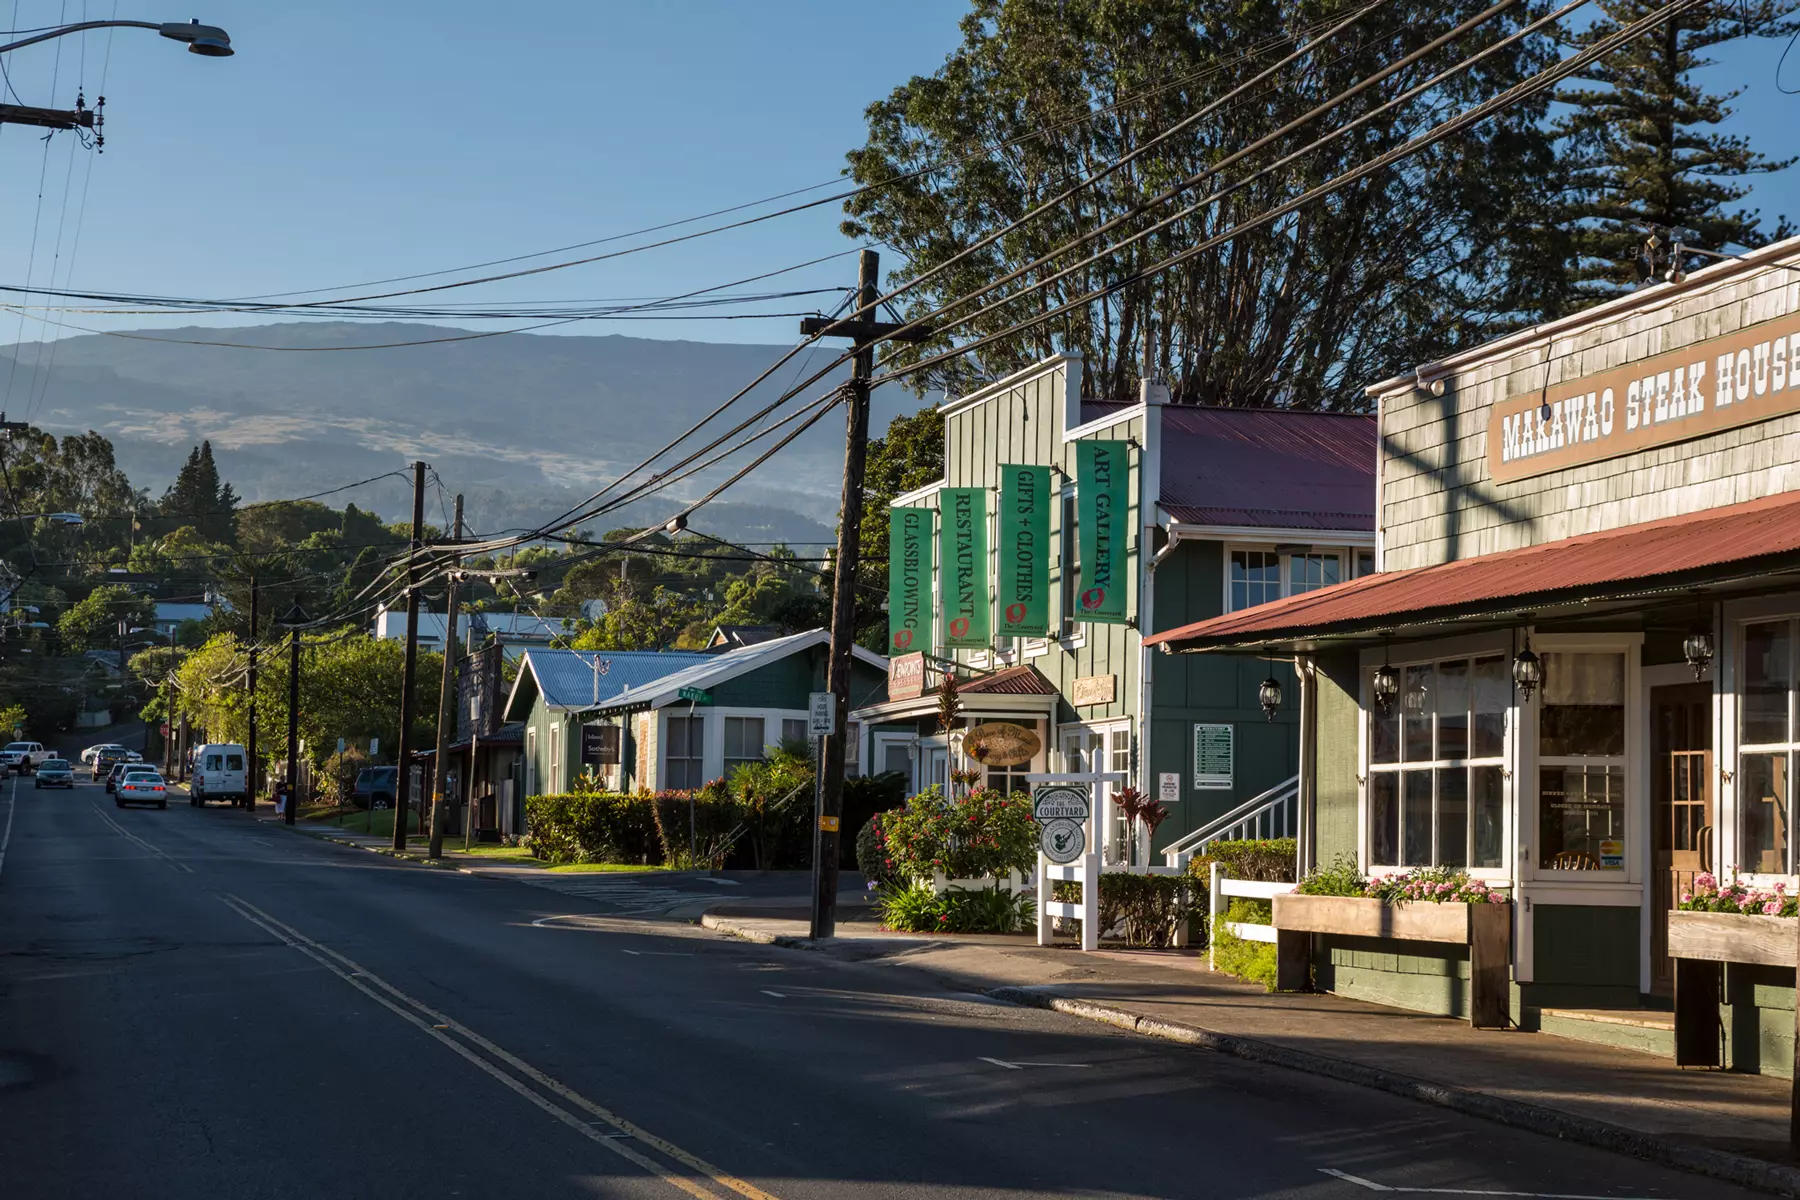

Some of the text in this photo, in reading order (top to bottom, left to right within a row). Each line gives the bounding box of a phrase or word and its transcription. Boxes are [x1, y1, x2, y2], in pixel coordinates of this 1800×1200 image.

[1503, 331, 1800, 462] MAKAWAO STEAK HOUSE
[904, 513, 919, 628] GLASSBLOWING
[956, 493, 974, 617] RESTAURANT
[1016, 471, 1034, 602] GIFTS + CLOTHES
[1094, 446, 1111, 588] ART GALLERY
[998, 725, 1006, 739] of
[1040, 806, 1084, 817] COURTYARD
